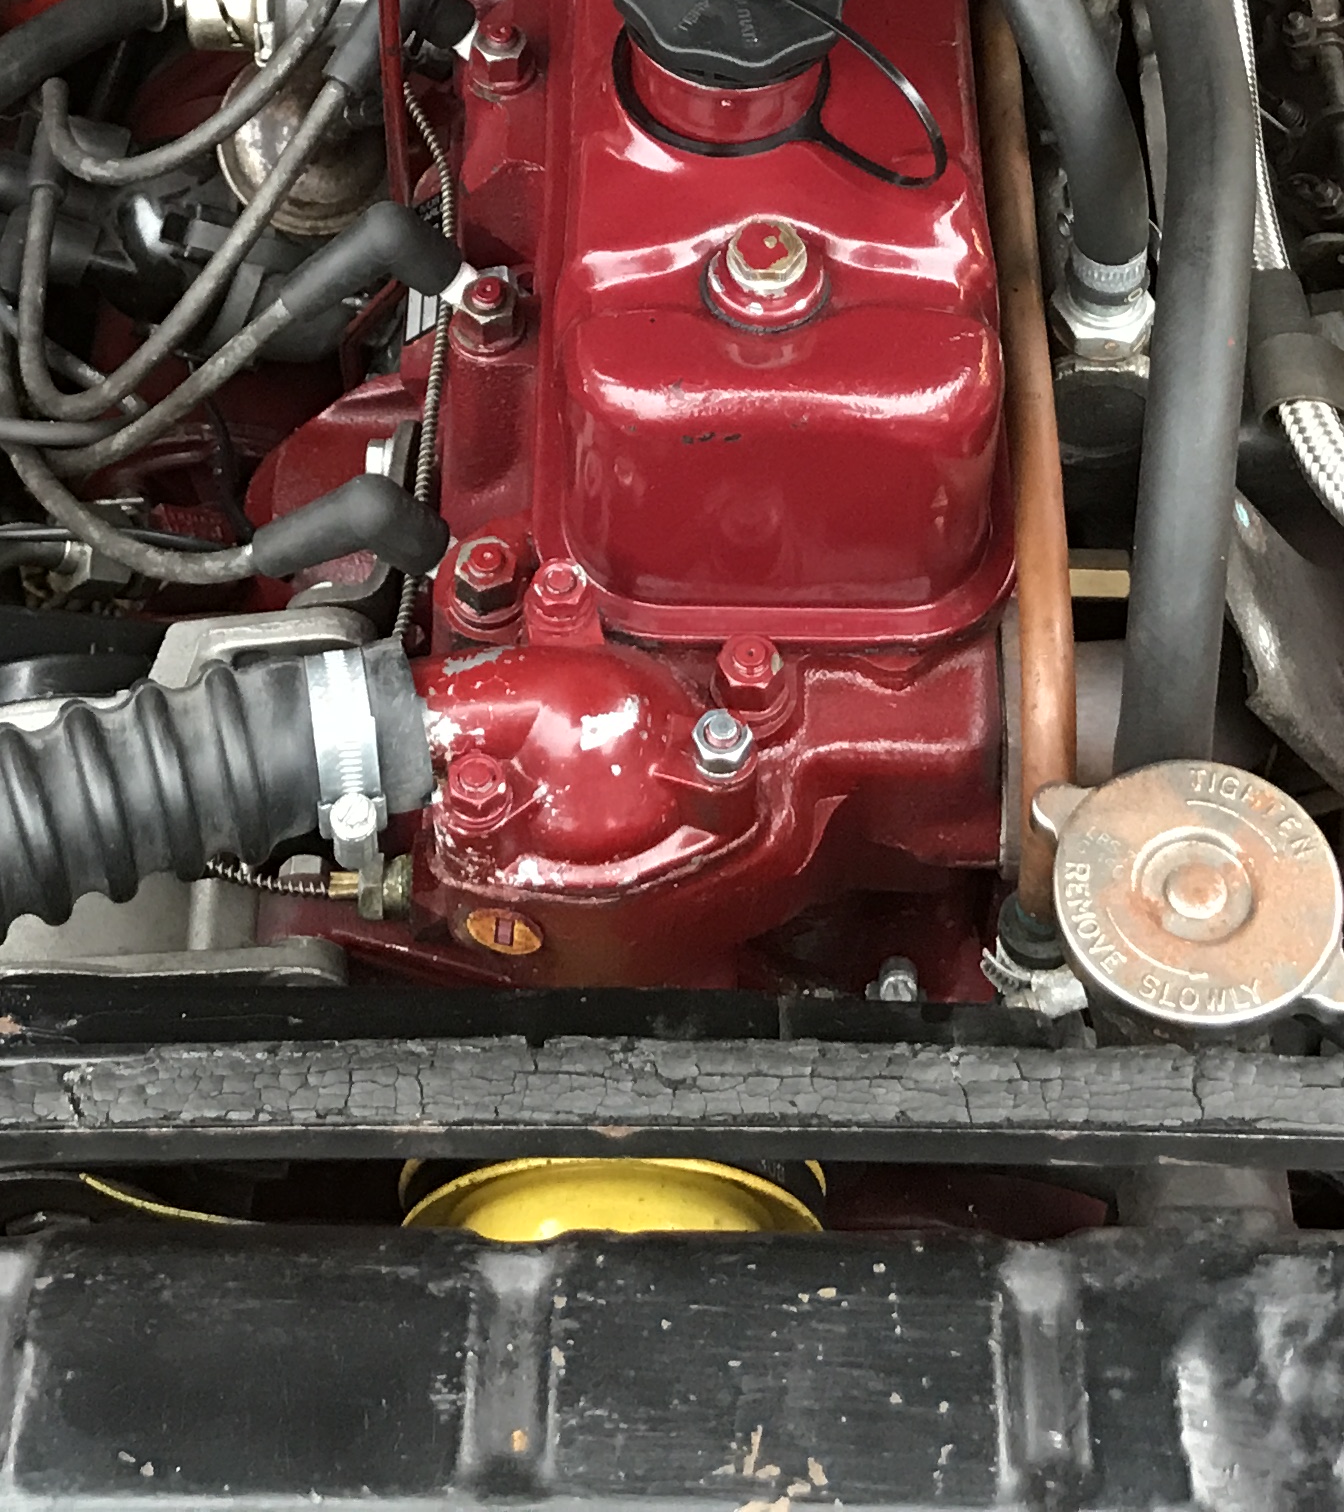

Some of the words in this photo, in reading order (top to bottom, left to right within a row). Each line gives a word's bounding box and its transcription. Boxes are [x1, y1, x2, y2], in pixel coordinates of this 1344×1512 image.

[1188, 769, 1321, 860] TIGHTEN
[1064, 861, 1128, 975] REMOVE
[1138, 974, 1262, 1013] SLOWLY
